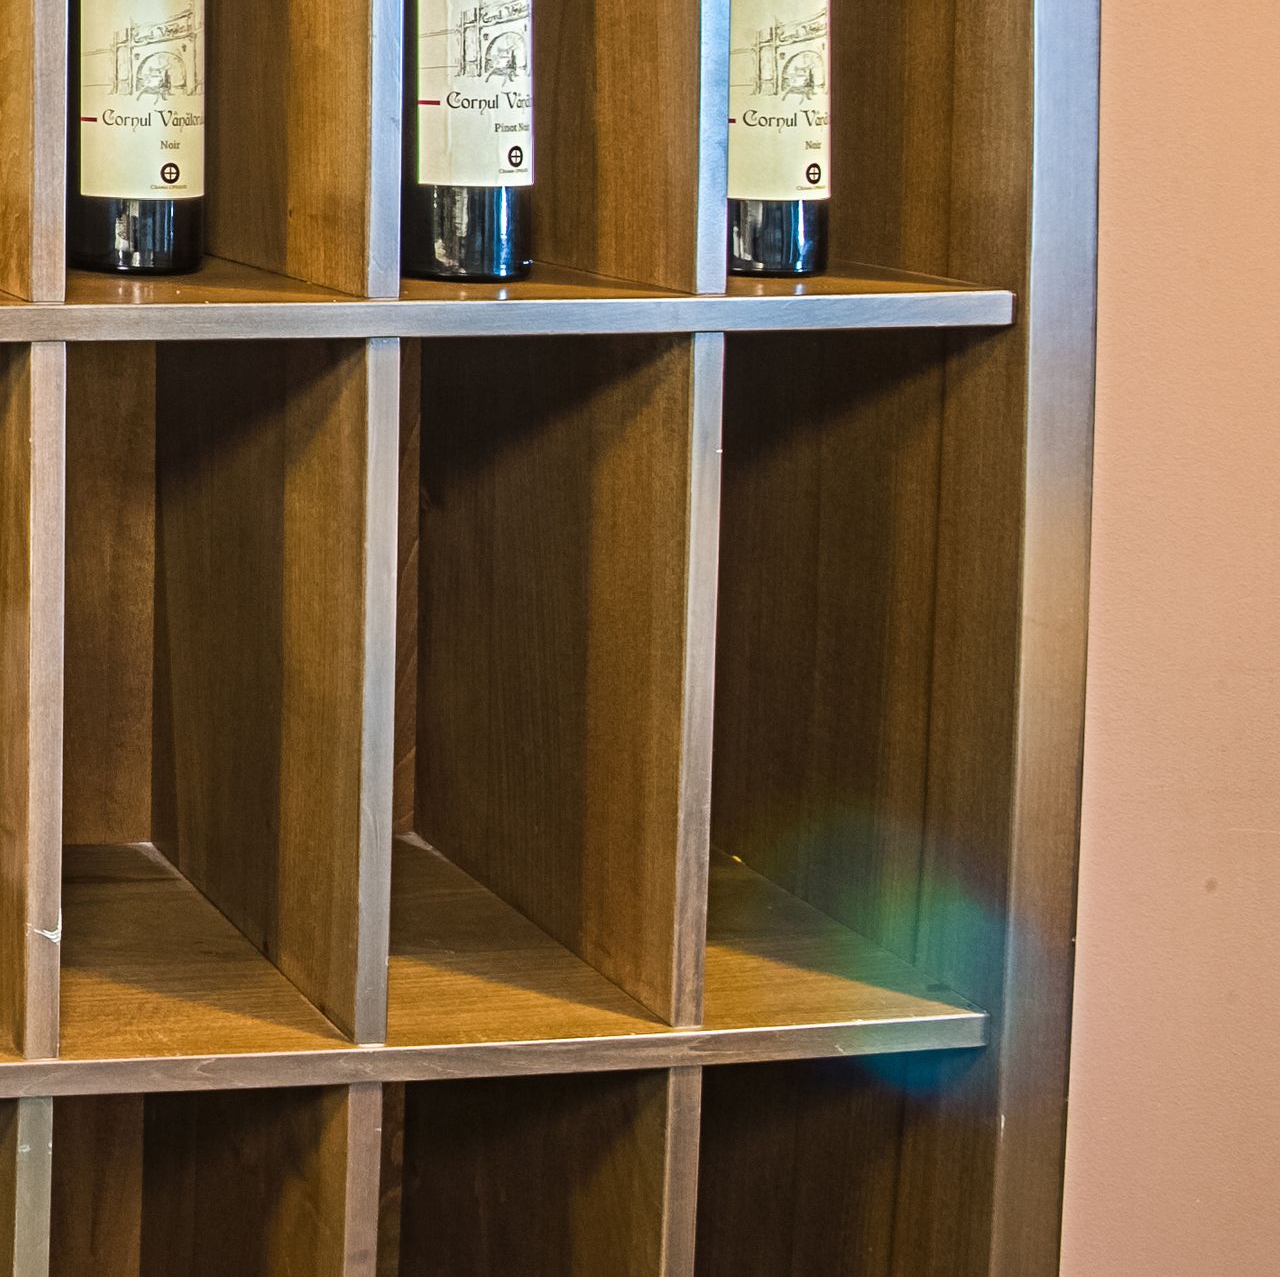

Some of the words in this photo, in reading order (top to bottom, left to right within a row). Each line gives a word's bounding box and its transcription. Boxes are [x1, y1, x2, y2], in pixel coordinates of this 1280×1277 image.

[446, 91, 499, 115] Cornul
[102, 108, 152, 133] Cornul
[743, 108, 797, 134] Cornul
[160, 140, 180, 150] Noir
